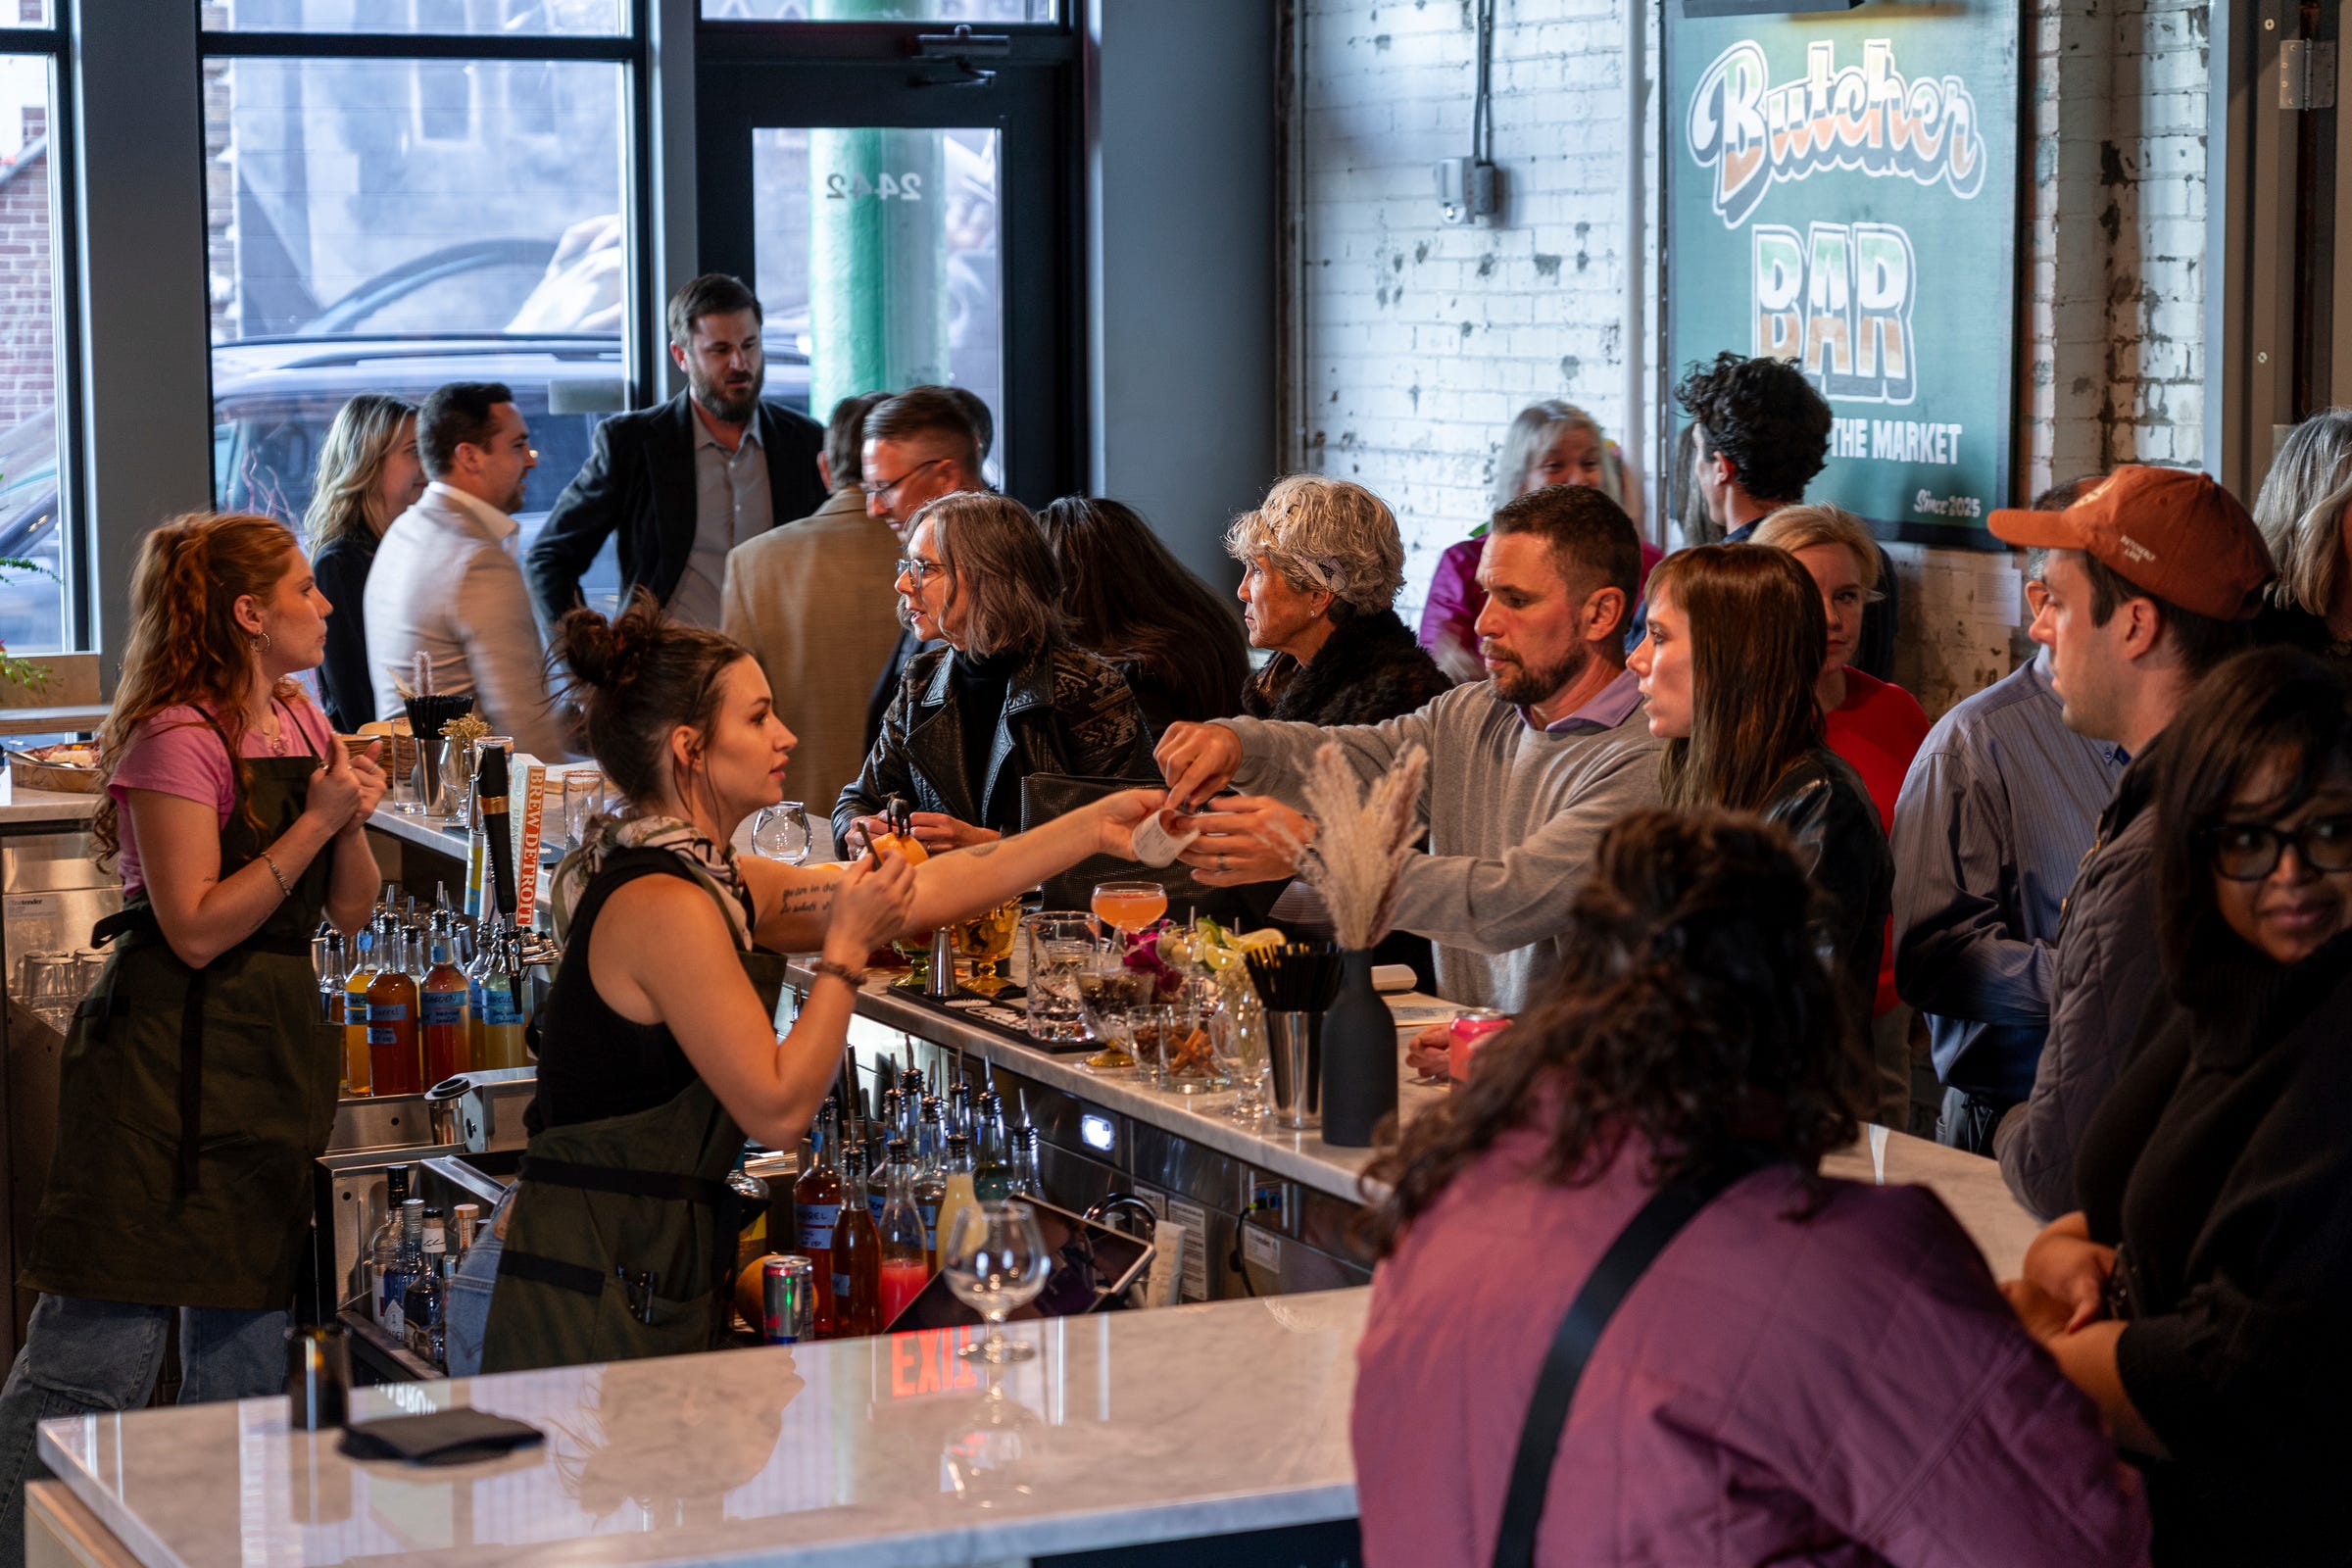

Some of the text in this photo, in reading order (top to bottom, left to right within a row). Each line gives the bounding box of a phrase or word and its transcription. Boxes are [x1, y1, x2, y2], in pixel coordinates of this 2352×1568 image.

[1686, 38, 1986, 230] Butcher
[1751, 220, 1917, 406] BAR
[1831, 417, 1963, 466] THE MARKET
[1914, 488, 1982, 518] Since 2025
[517, 769, 545, 925] BREW DETROIT
